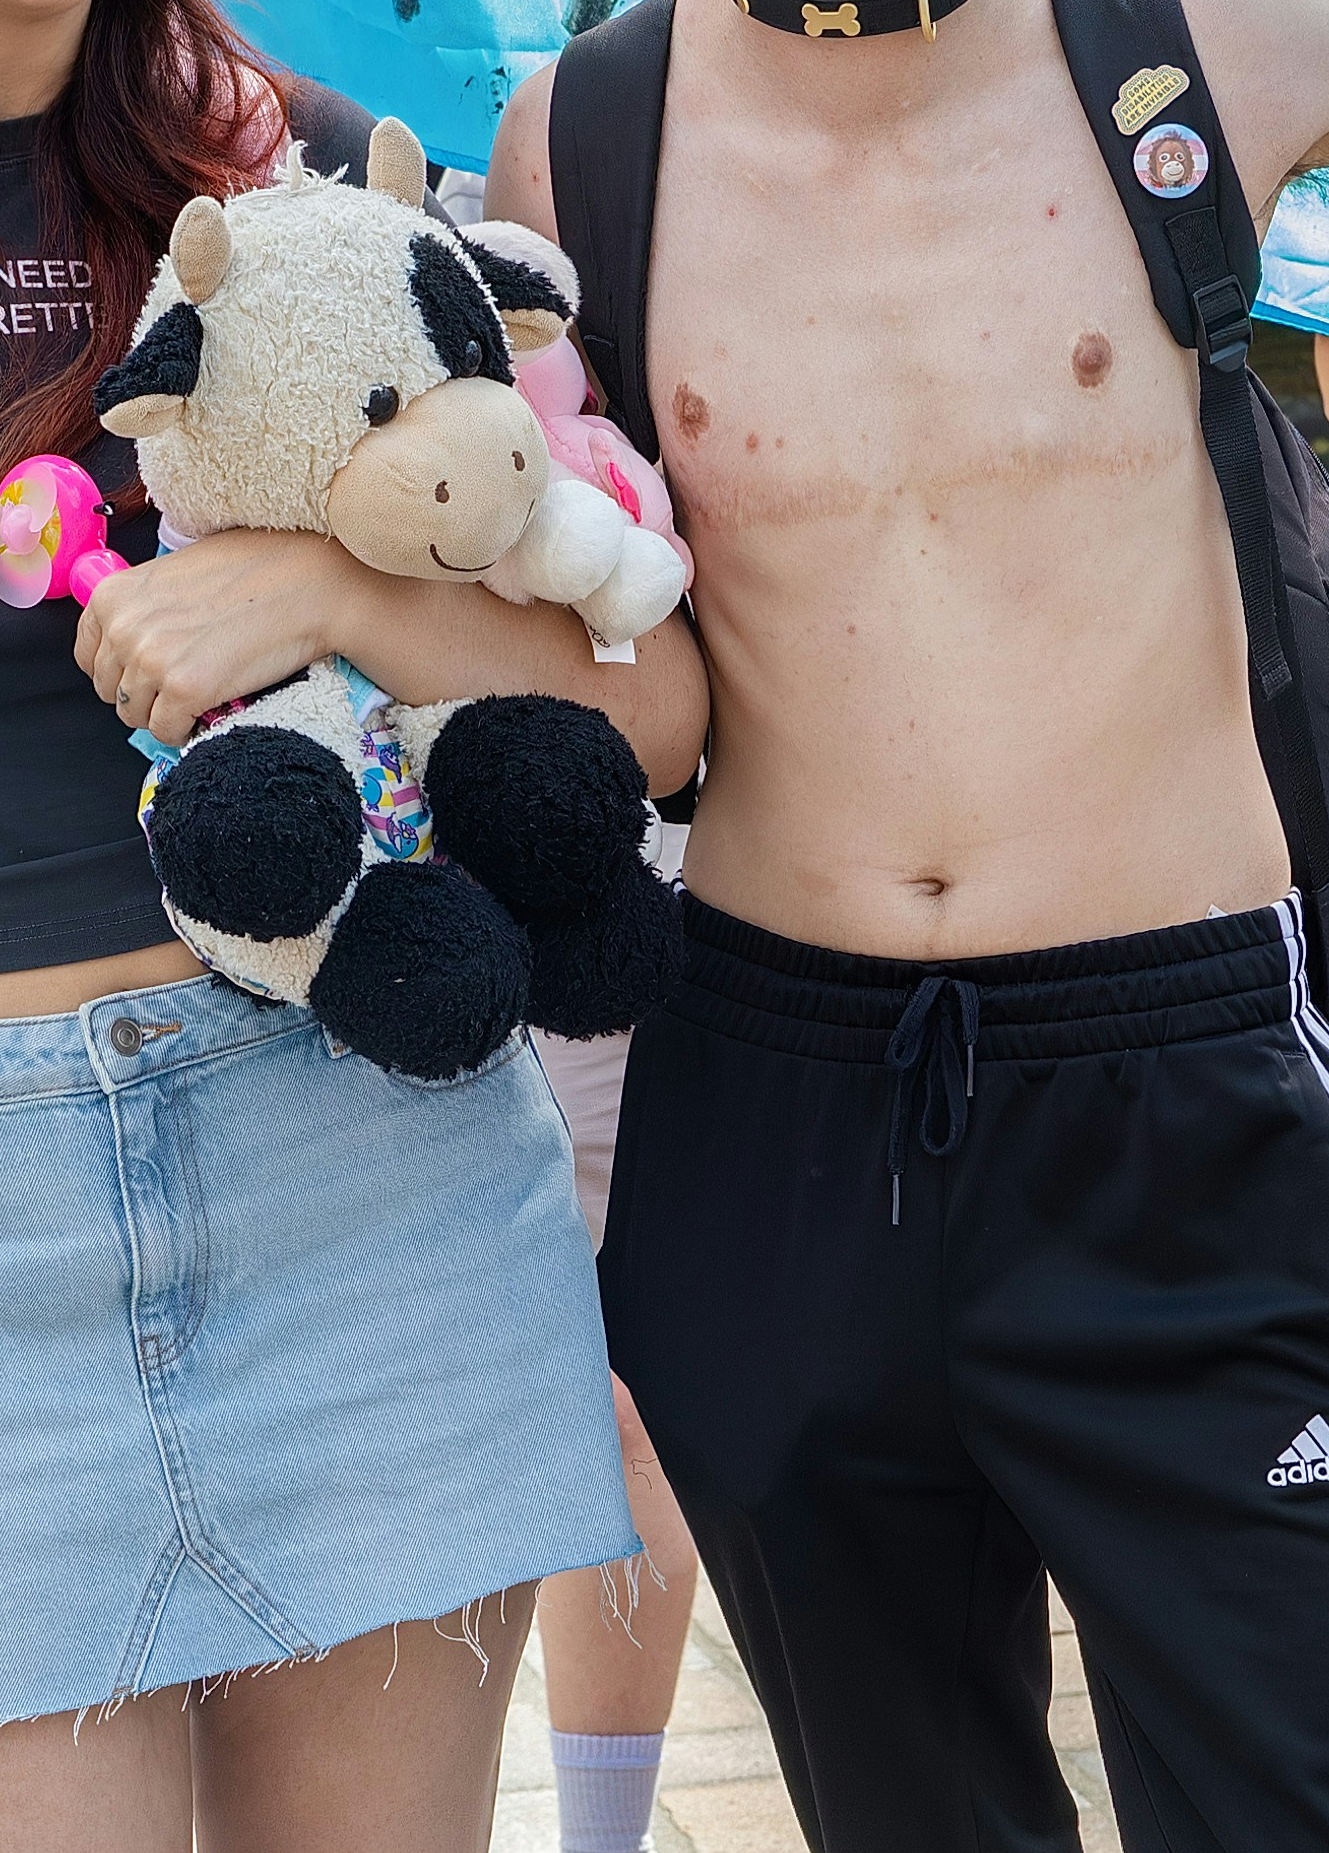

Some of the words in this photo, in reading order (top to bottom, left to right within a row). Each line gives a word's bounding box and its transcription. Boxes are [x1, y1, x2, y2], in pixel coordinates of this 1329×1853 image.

[1122, 74, 1170, 116] DISABILITIES
[1125, 109, 1142, 126] ARE
[1141, 77, 1180, 112] INVISIBLE
